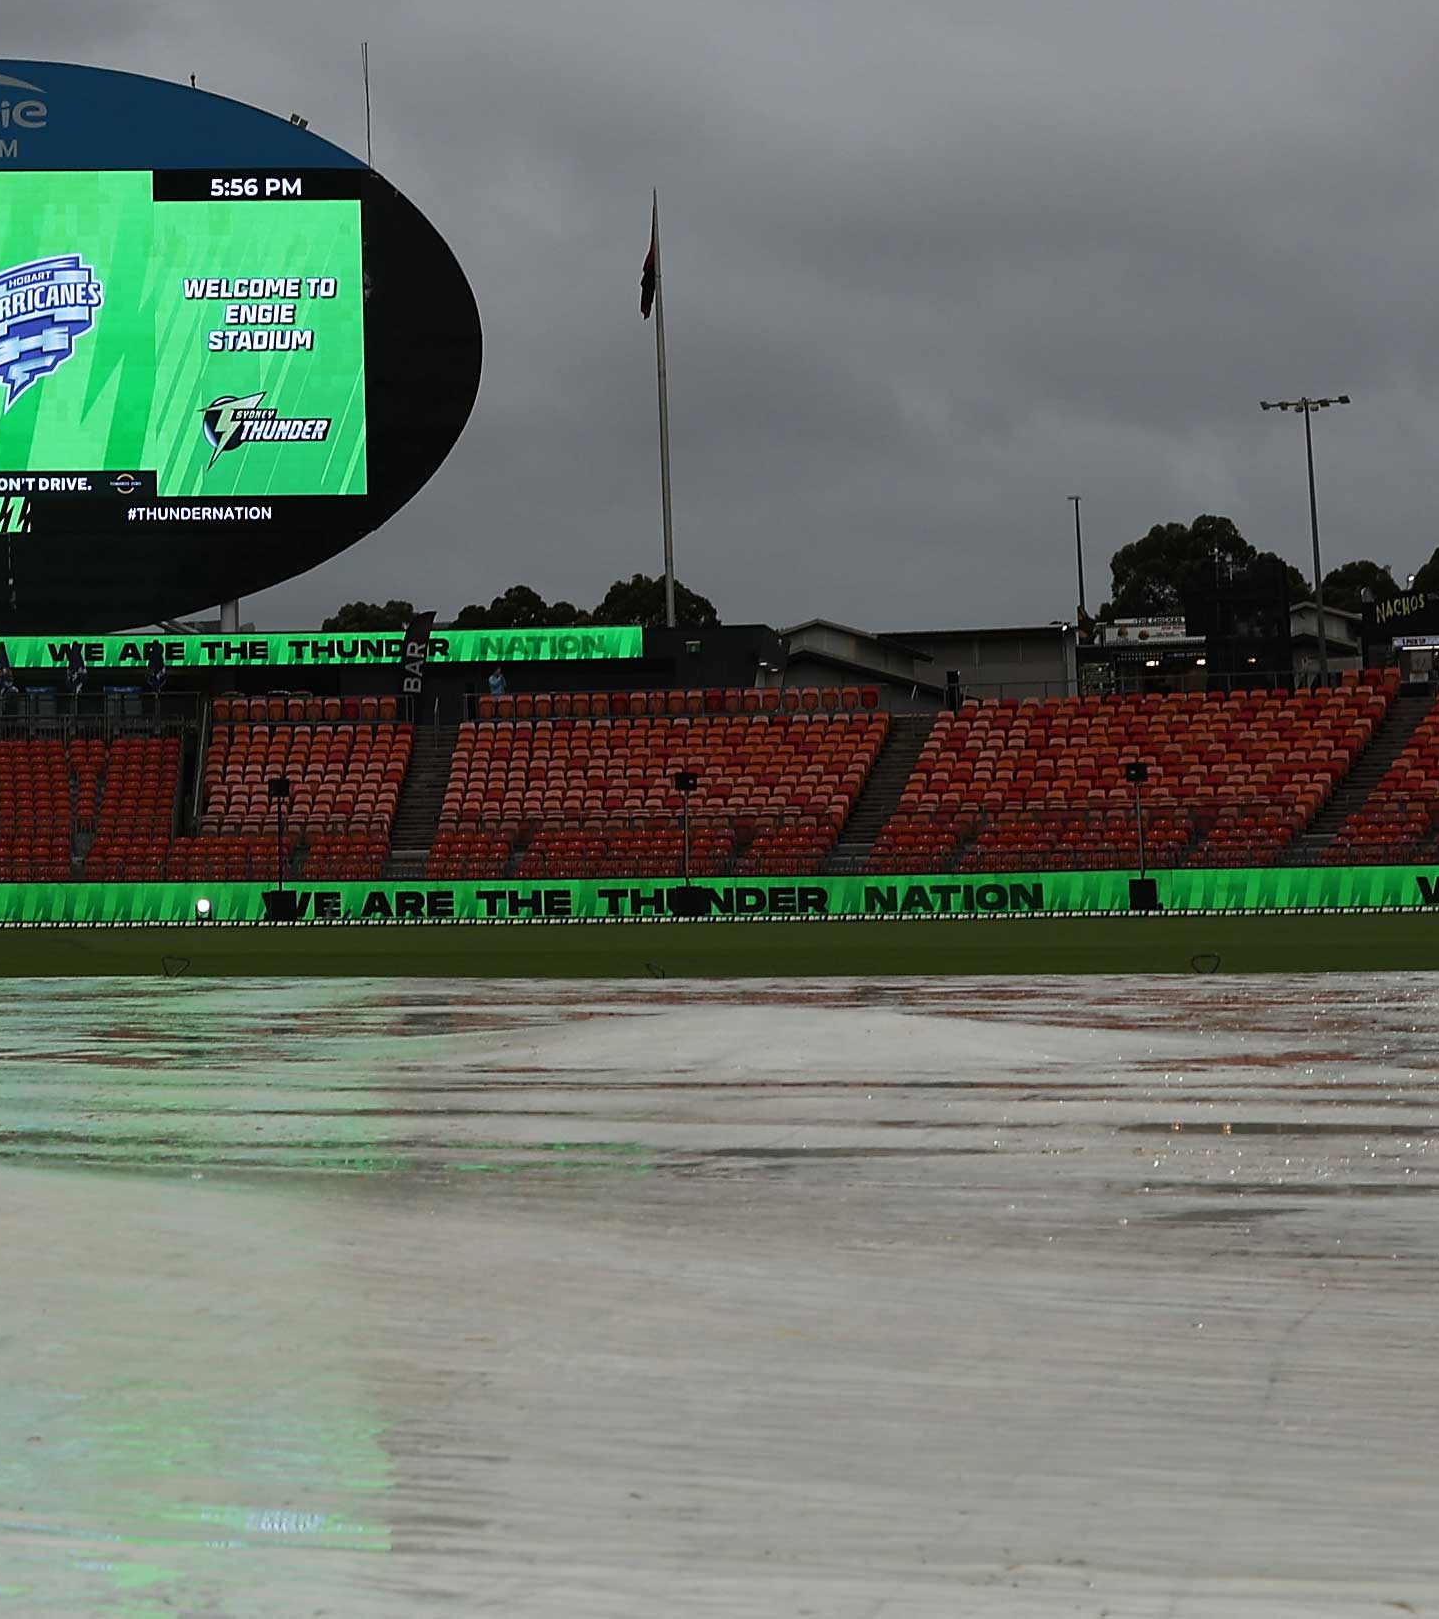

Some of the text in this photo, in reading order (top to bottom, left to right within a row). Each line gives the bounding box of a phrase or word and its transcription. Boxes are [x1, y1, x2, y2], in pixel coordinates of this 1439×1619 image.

[210, 178, 302, 196] 5:56 PM
[9, 270, 51, 289] HOBART
[183, 277, 336, 298] WELCOME TO
[225, 304, 295, 324] ENGIE
[208, 330, 312, 350] STADIUM
[235, 409, 275, 419] SYDNEY
[240, 420, 328, 441] THUNDER
[39, 478, 92, 491] DRIVE.
[127, 506, 272, 521] #THUNDERNATION
[1375, 593, 1426, 623] NACHOS
[48, 642, 104, 661] WE
[201, 640, 268, 659] THE
[288, 637, 449, 658] THUNDR
[481, 635, 607, 656] NATION
[402, 639, 426, 694] BAR
[362, 891, 455, 917] ARE
[476, 889, 571, 916] THE
[598, 885, 828, 915] THNDER
[865, 883, 1044, 911] NATION
